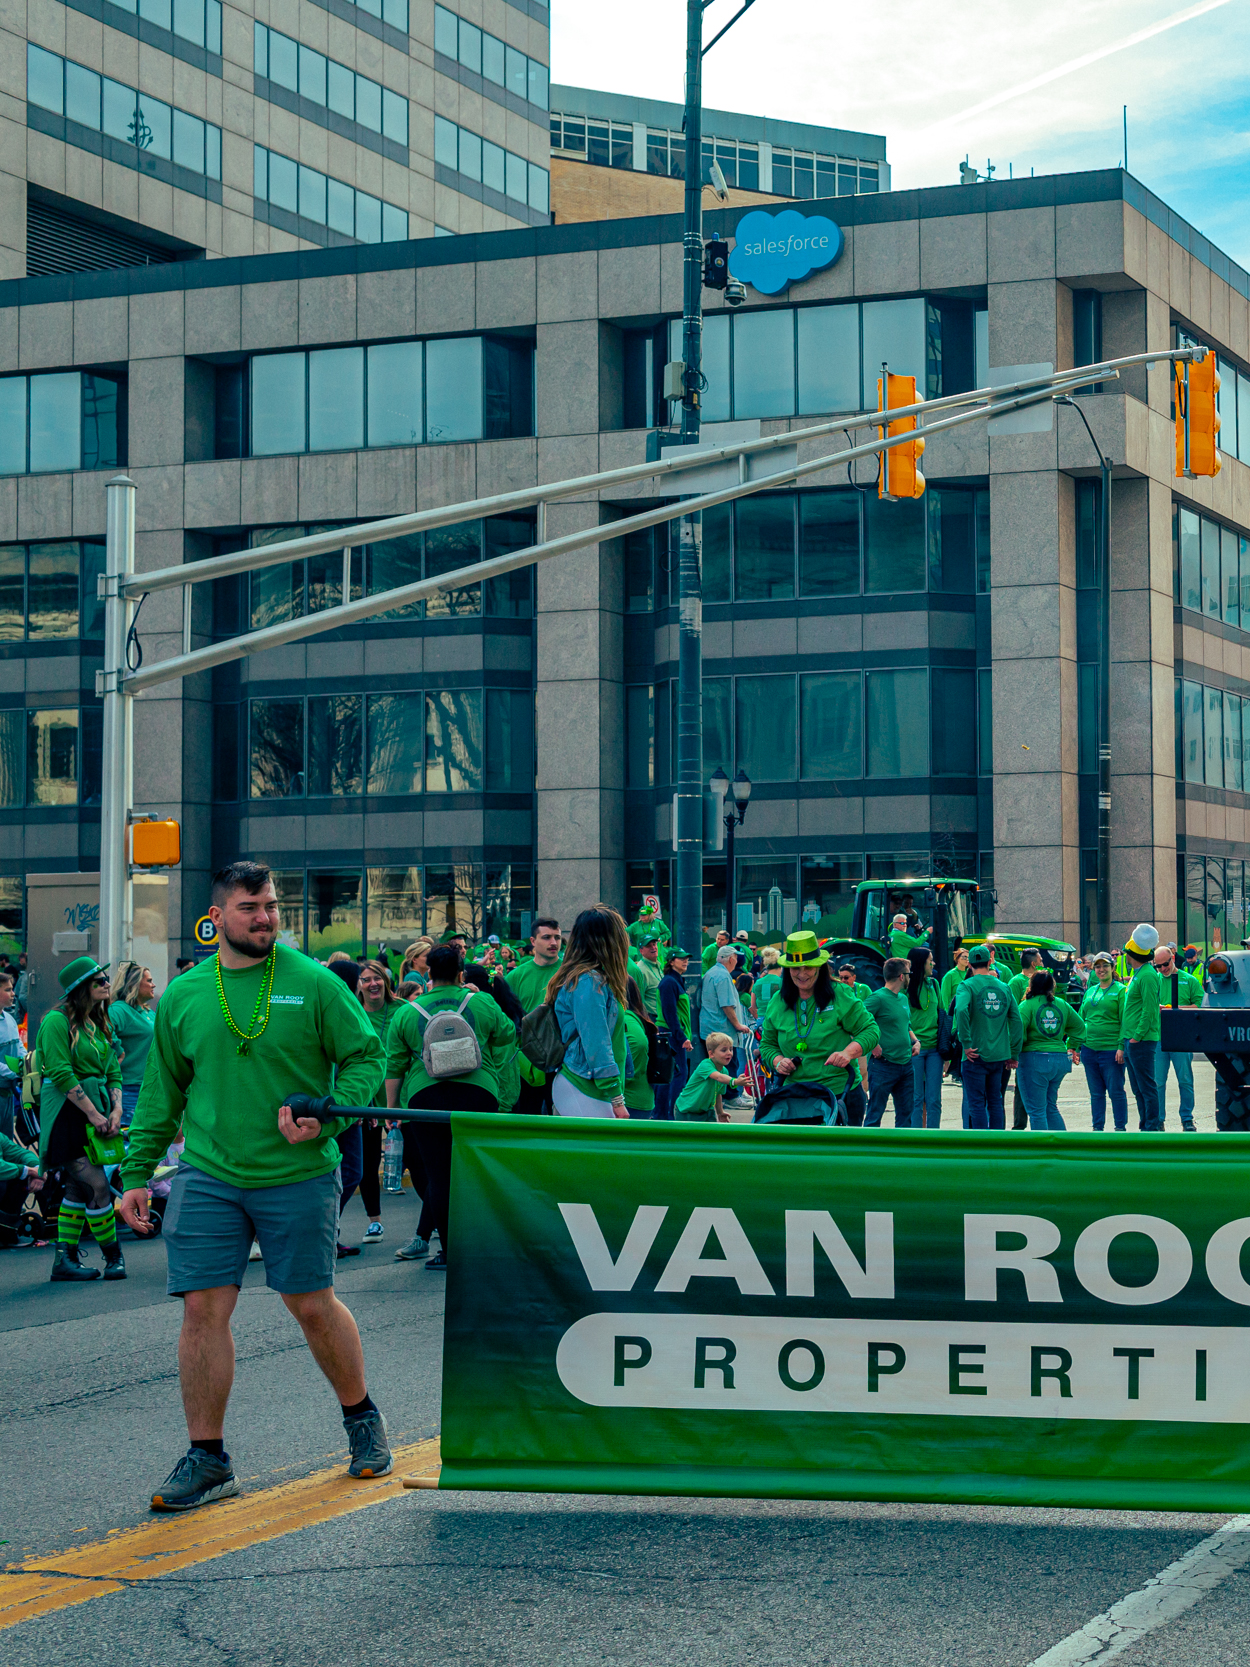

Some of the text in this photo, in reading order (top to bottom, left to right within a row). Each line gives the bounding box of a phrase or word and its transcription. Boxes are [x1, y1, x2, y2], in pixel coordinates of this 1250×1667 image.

[744, 234, 829, 257] salesforce
[202, 922, 214, 938] B
[557, 1202, 895, 1299] VAN
